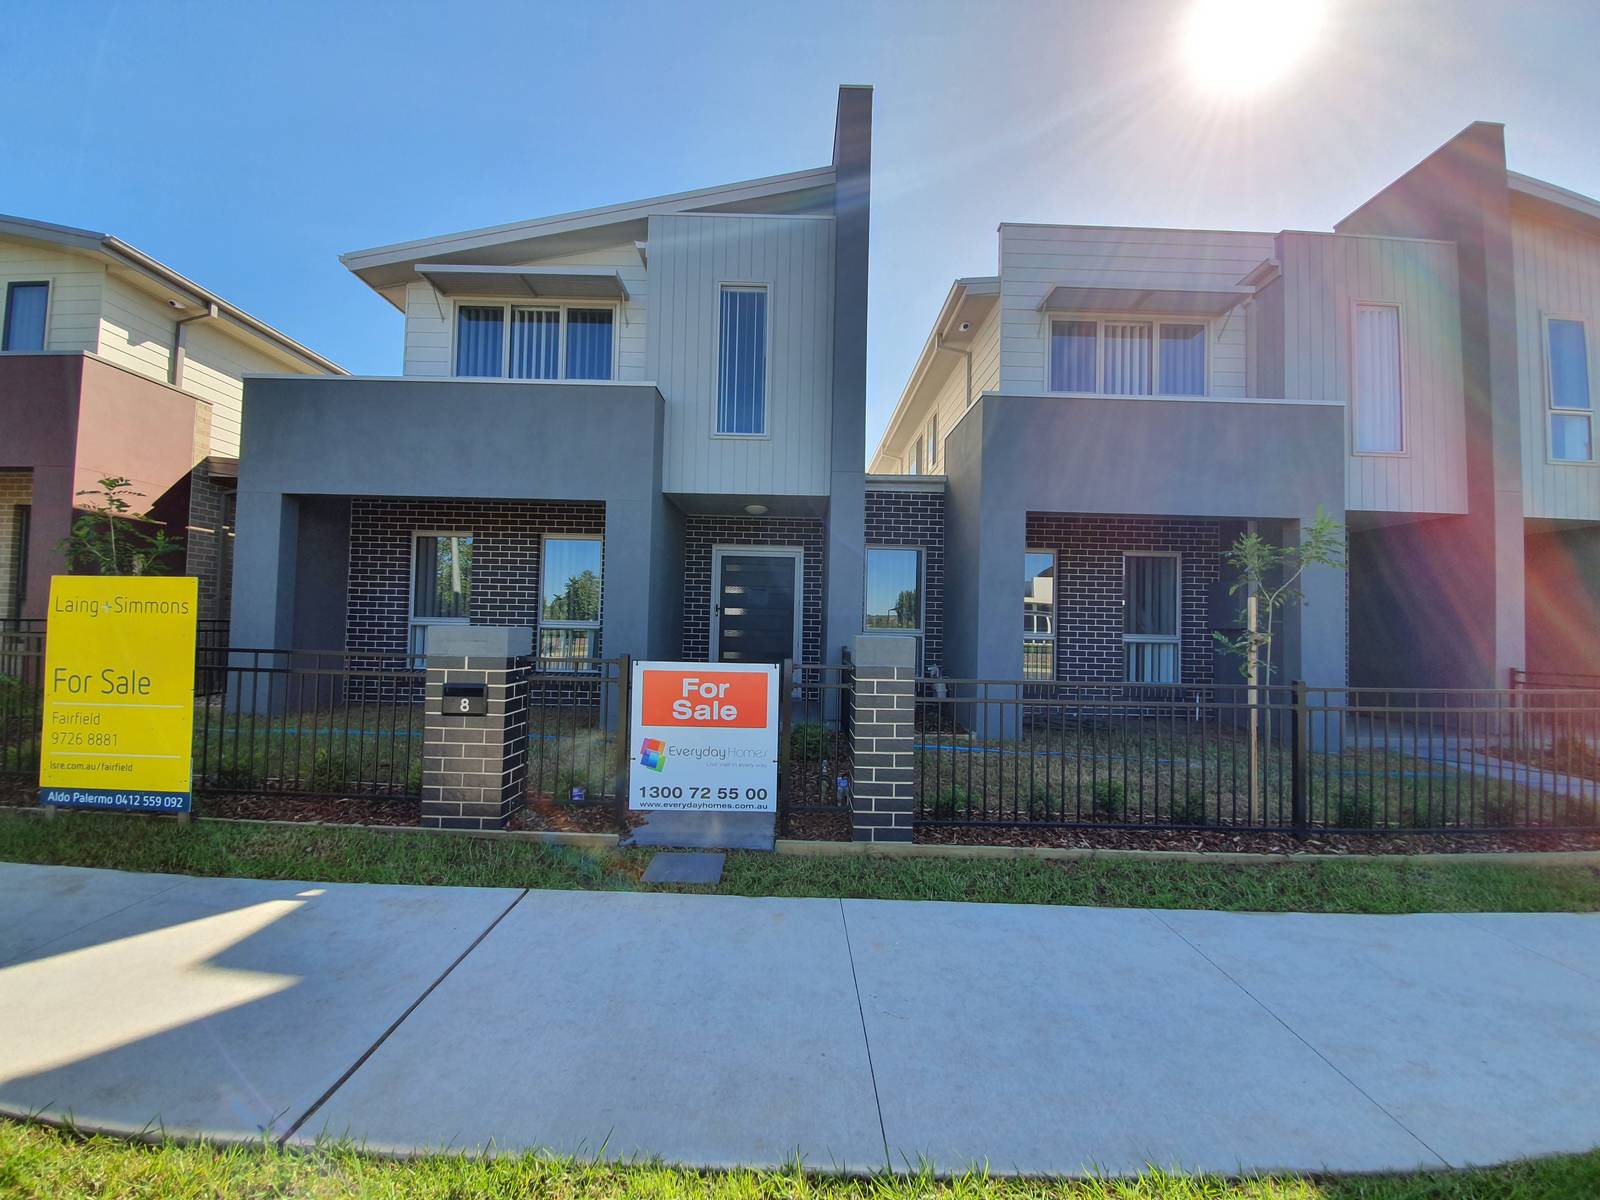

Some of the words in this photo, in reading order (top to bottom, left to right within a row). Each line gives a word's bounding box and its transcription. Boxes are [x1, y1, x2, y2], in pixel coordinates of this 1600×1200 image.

[54, 668, 92, 693] For
[101, 669, 151, 695] Sale
[682, 678, 730, 698] For
[460, 698, 470, 712] 8
[672, 699, 738, 721] Sale
[52, 712, 101, 726] Fairfield
[51, 732, 83, 746] 9726
[87, 734, 118, 747] 8881
[50, 760, 133, 772] lsre.com.au/fairfield
[48, 791, 71, 803] Aldo
[73, 792, 113, 805] Palermo
[115, 794, 140, 806] 0412
[143, 795, 161, 807] 559
[164, 796, 183, 808] 092
[639, 786, 683, 799] 1300
[689, 787, 711, 799] 72
[717, 788, 739, 800] 55
[745, 788, 768, 801] 00
[639, 801, 768, 811] www.everydayhomes.com.au
